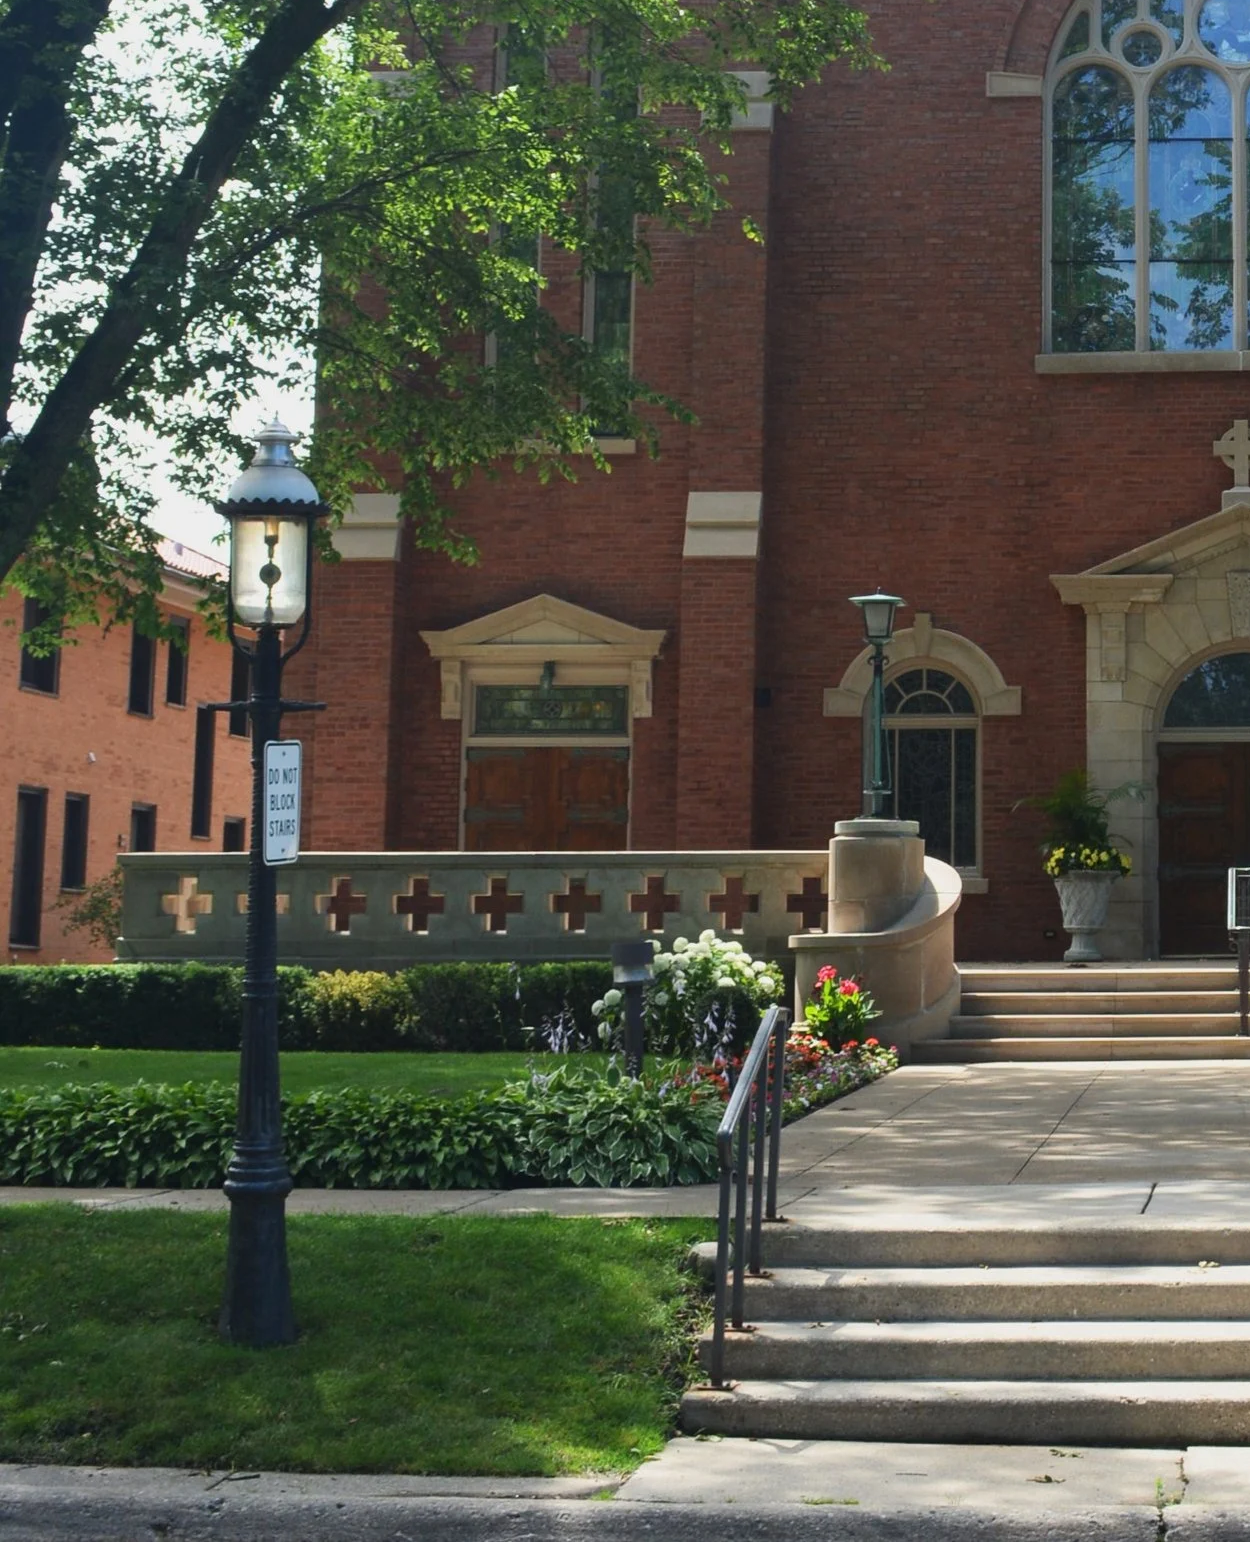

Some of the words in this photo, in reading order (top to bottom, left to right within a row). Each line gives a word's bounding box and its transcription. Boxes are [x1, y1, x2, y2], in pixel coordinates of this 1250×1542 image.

[268, 768, 279, 785] DO
[283, 767, 298, 784] NOT
[270, 794, 295, 811] BLOCK
[269, 819, 296, 837] STAIRS
